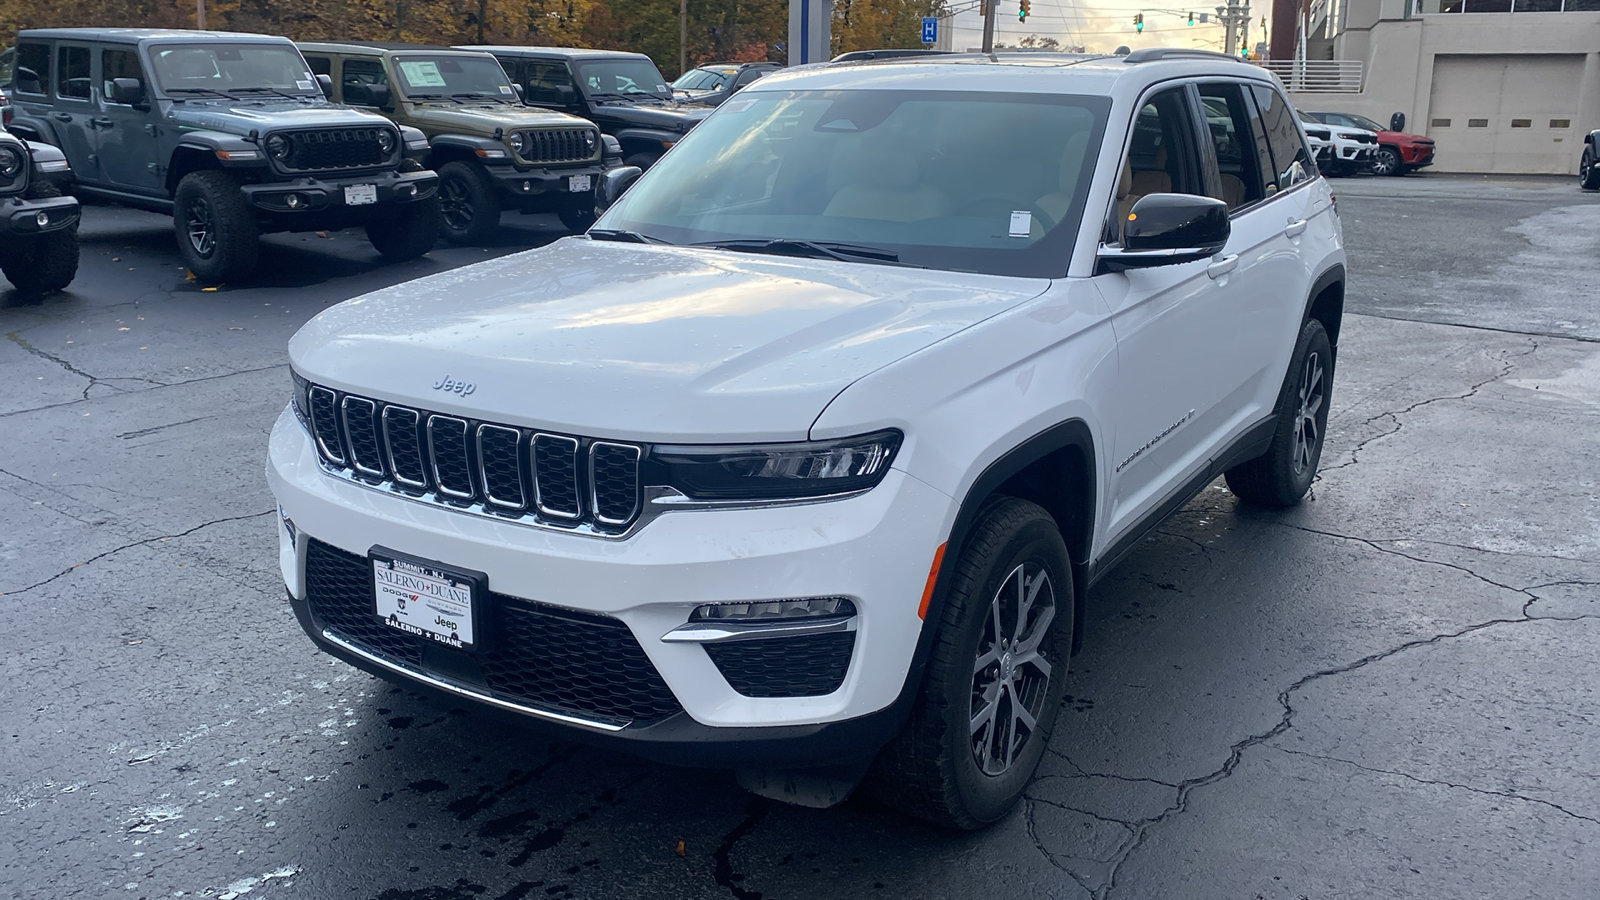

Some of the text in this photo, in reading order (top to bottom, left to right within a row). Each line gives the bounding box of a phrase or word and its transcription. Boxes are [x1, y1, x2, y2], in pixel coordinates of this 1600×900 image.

[925, 23, 934, 35] H
[432, 374, 477, 398] Jeep
[432, 570, 444, 579] NJ
[377, 569, 469, 604] SALERNO DUANE
[382, 587, 411, 599] DODGE
[434, 615, 458, 631] Jeep
[385, 618, 463, 648] SALERNO DUANE
